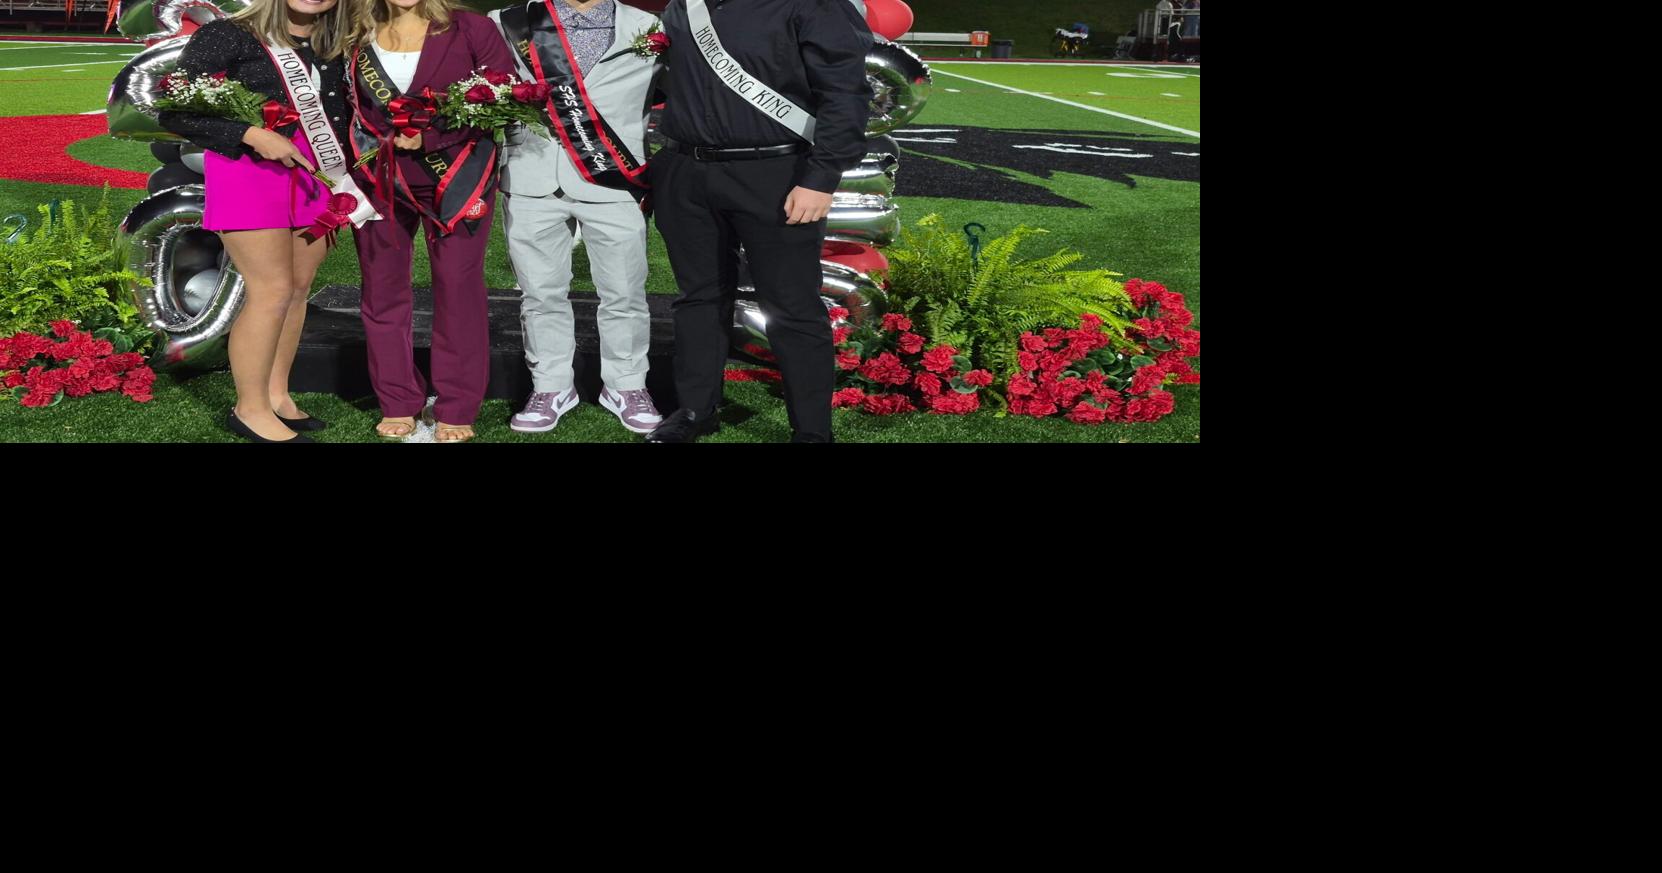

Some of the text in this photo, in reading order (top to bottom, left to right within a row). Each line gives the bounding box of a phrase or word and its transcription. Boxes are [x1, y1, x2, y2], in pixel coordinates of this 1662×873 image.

[357, 48, 393, 107] OMECO
[695, 26, 792, 119] HOMECOMING KING
[277, 52, 344, 171] HOMECOMING QUEEN
[592, 152, 608, 171] King
